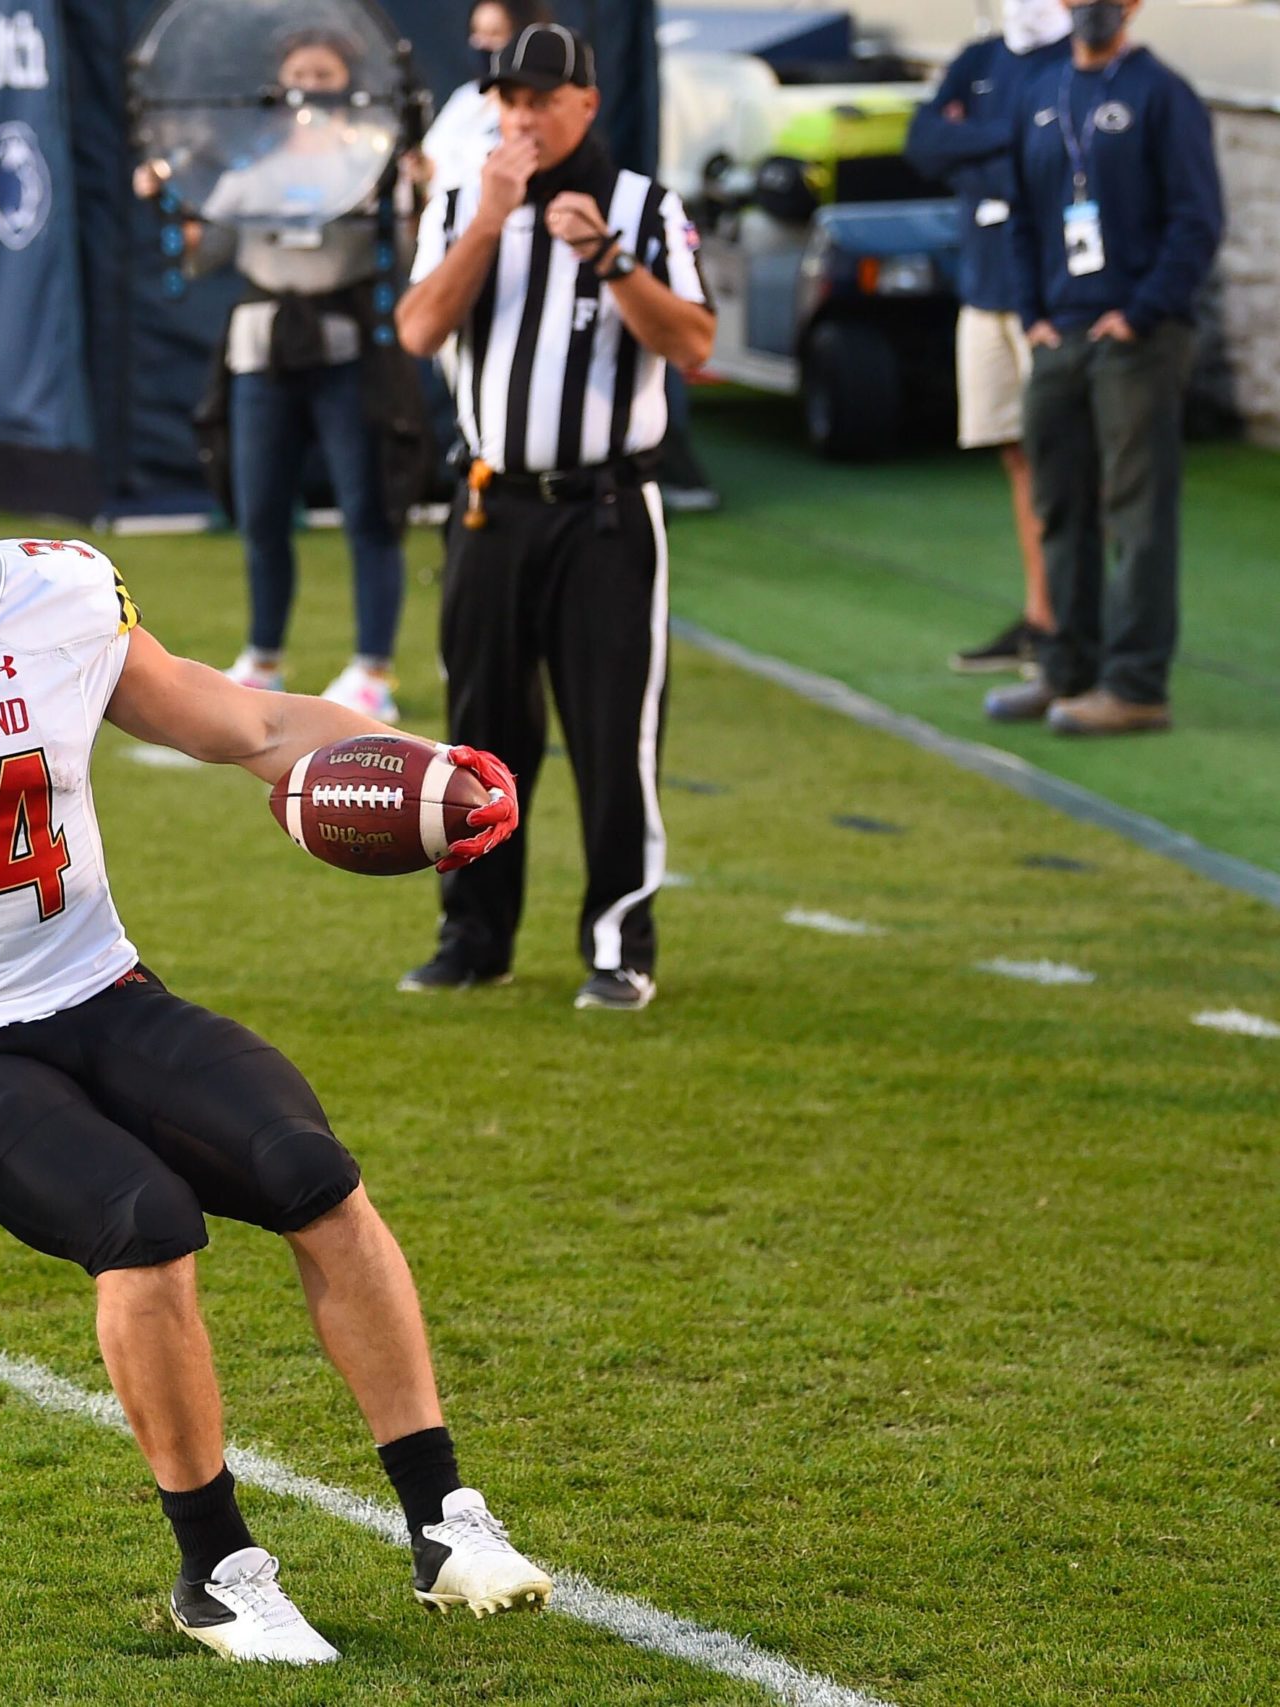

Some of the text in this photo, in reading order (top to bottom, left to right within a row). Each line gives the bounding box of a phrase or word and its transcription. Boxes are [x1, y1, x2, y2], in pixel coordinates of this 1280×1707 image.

[575, 297, 598, 331] F
[328, 751, 405, 774] Wilson
[317, 821, 394, 845] Wilson
